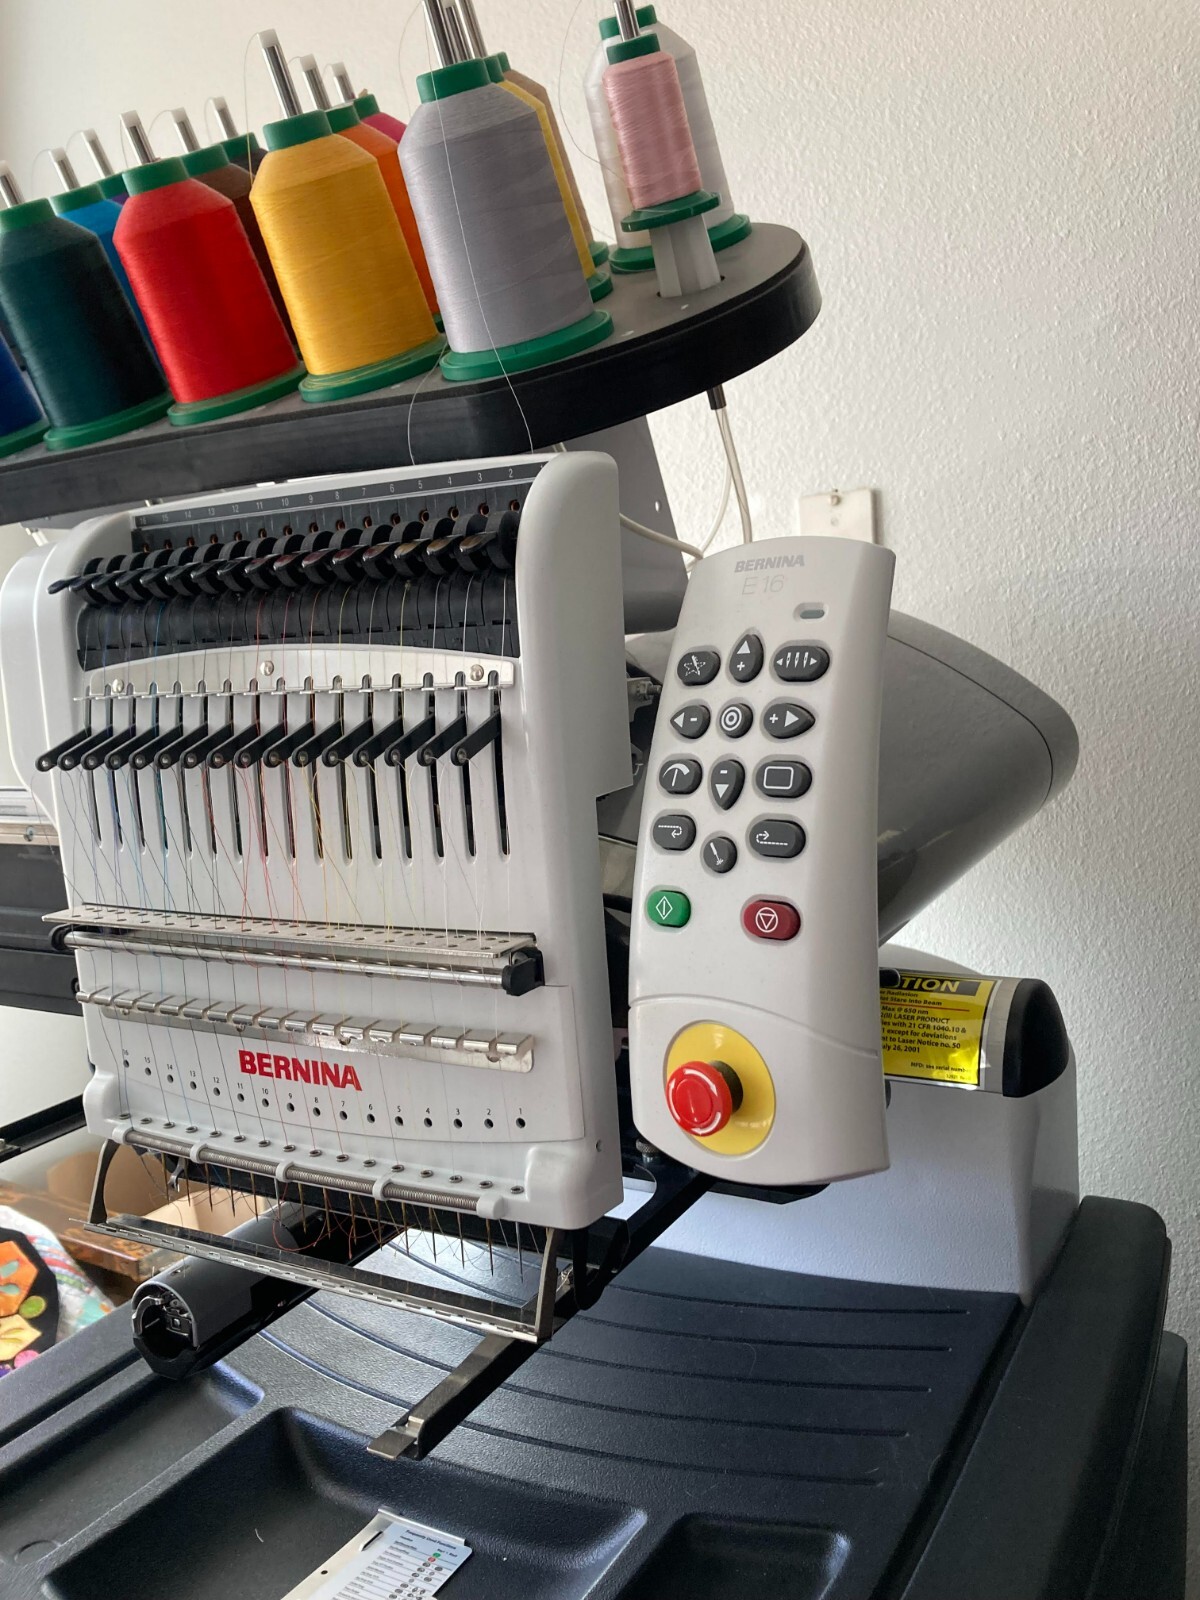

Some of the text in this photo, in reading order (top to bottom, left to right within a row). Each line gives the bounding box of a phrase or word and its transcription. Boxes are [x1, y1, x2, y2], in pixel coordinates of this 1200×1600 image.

[162, 514, 169, 522] 15
[184, 510, 192, 519] 14
[208, 507, 216, 516] 13
[232, 504, 239, 513] 12
[256, 501, 264, 510] 11
[281, 498, 290, 506] 10
[308, 494, 314, 504] 9
[334, 491, 340, 500] 8
[362, 487, 367, 496] 7
[389, 483, 395, 493] 6
[418, 480, 423, 490] 5
[447, 476, 452, 486] 4
[477, 472, 483, 482] 3
[508, 468, 514, 478] 2
[734, 554, 806, 573] BERNINA
[902, 976, 960, 993] TION
[916, 1016, 950, 1024] PRODUCT
[886, 1028, 909, 1036] except
[921, 1031, 956, 1040] deviations
[933, 1024, 960, 1032] 1040.10
[916, 1039, 938, 1047] Notice
[904, 1046, 920, 1054] 2001
[190, 1070, 196, 1078] 13
[212, 1076, 220, 1084] 12
[238, 1049, 363, 1092] BERNINA
